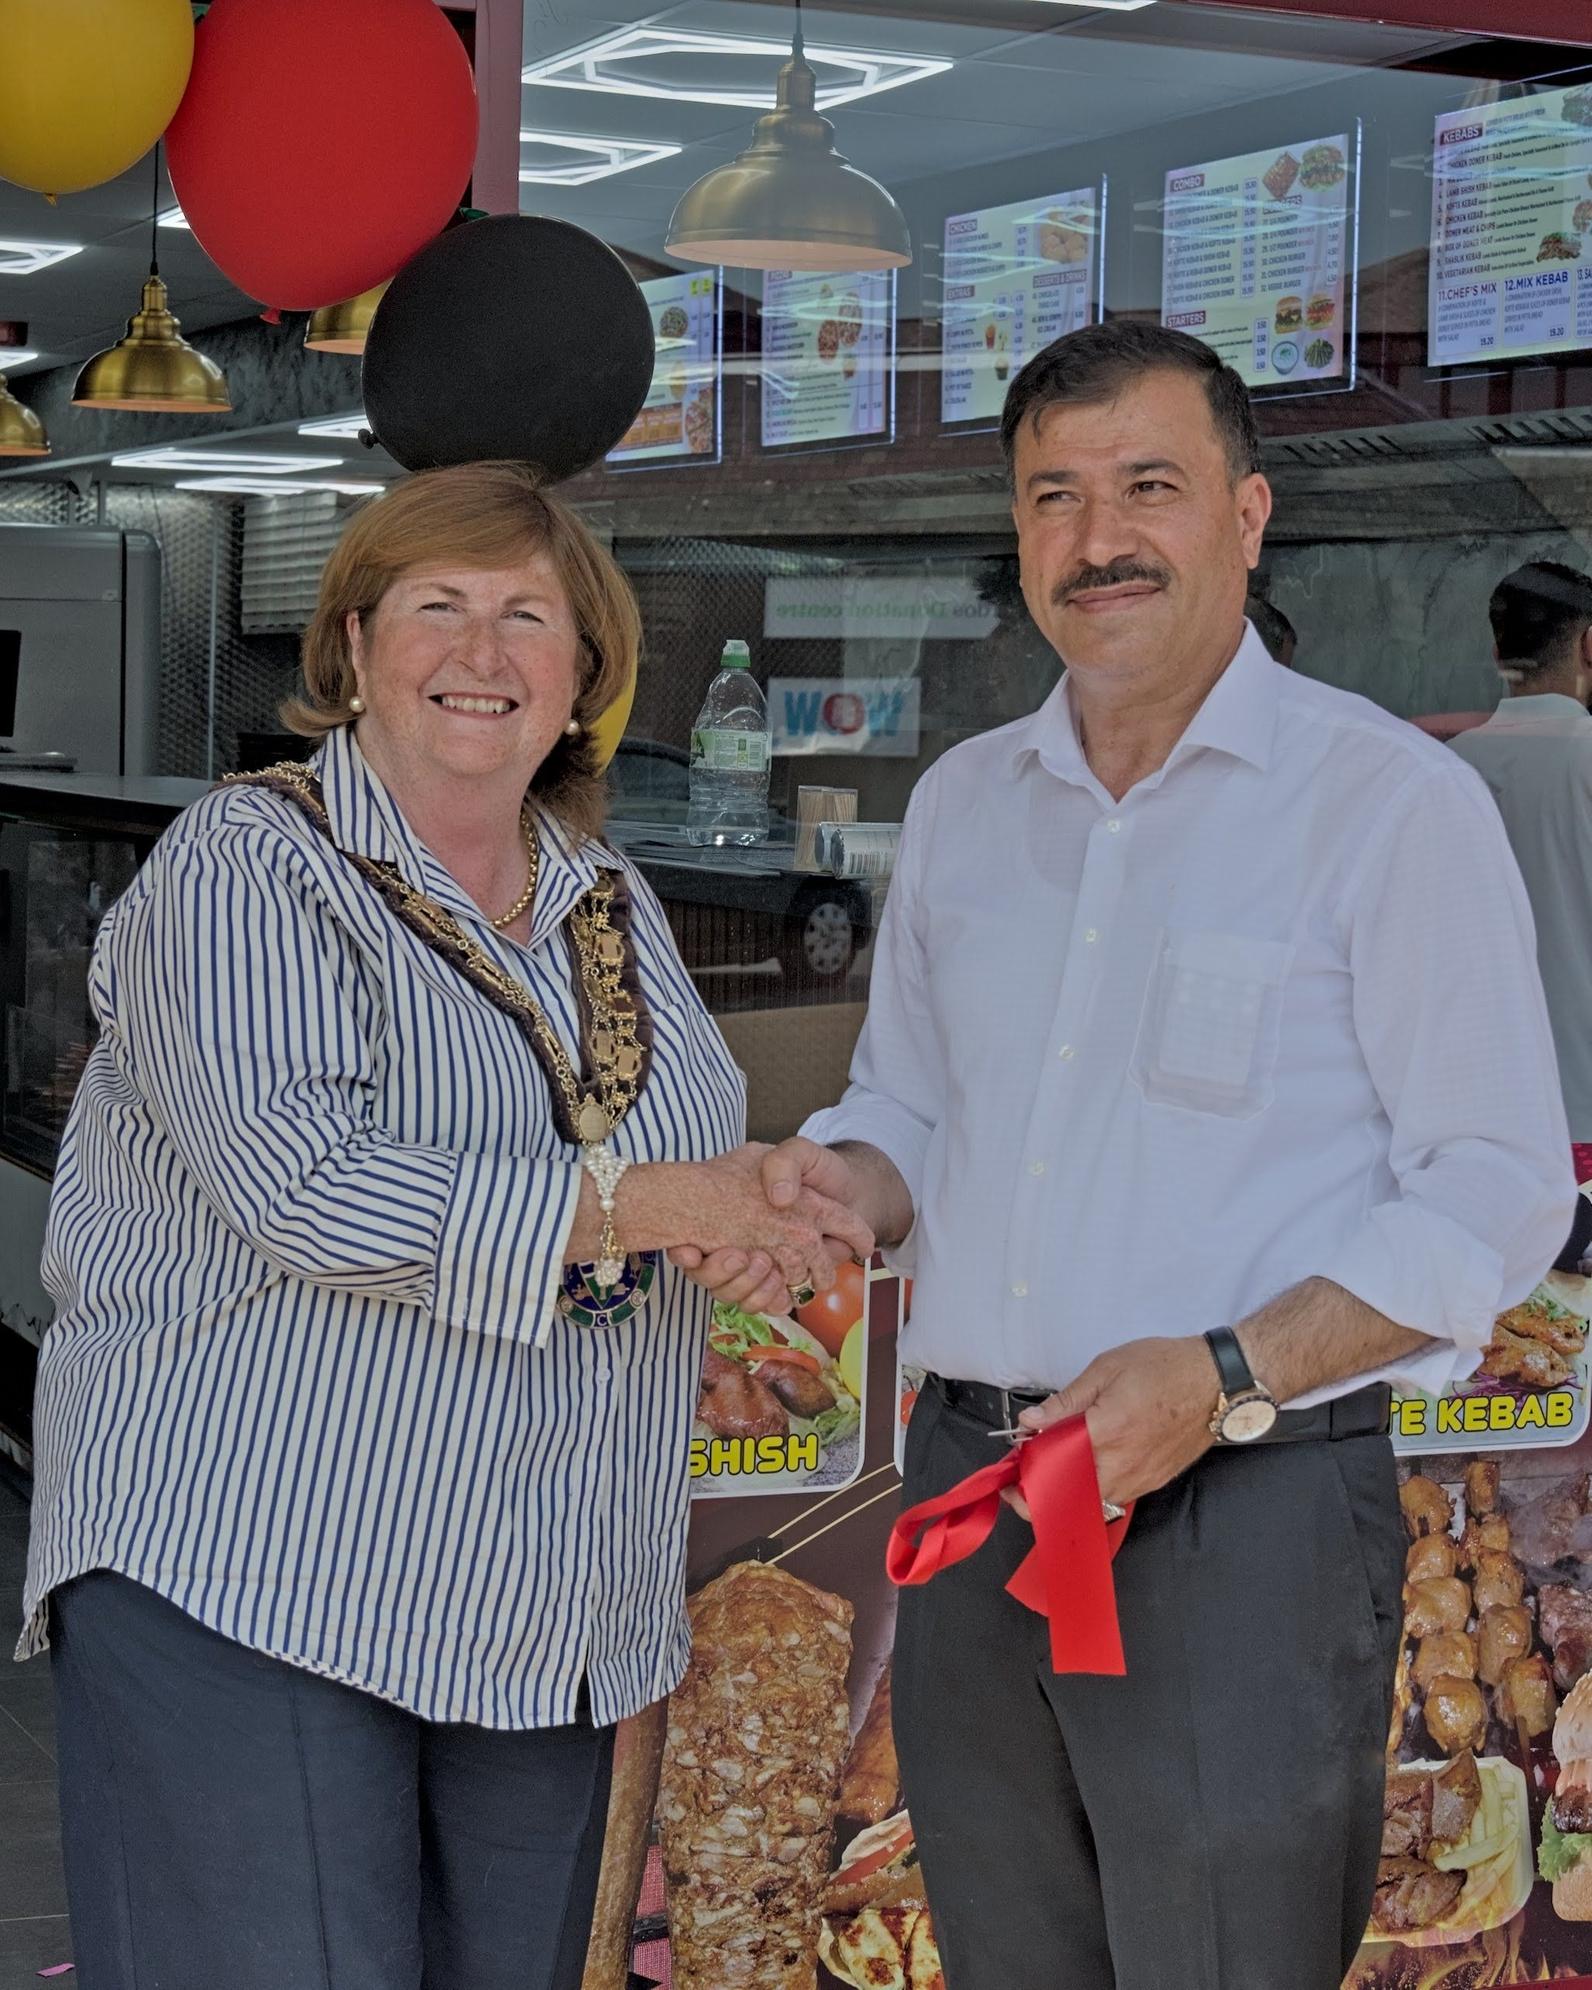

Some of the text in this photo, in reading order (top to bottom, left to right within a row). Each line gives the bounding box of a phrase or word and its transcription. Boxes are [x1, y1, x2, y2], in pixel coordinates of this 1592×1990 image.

[1444, 126, 1479, 143] KEBABS
[1174, 176, 1201, 190] COMBO
[1444, 266, 1474, 279] VEGETARIAN
[1474, 264, 1490, 273] KEBAB
[1505, 271, 1568, 291] 12.MIX KEBAB
[1438, 282, 1496, 301] 11.CHEF'S MIX
[1168, 312, 1204, 328] STARTERS
[1436, 1392, 1574, 1434] KEBAB
